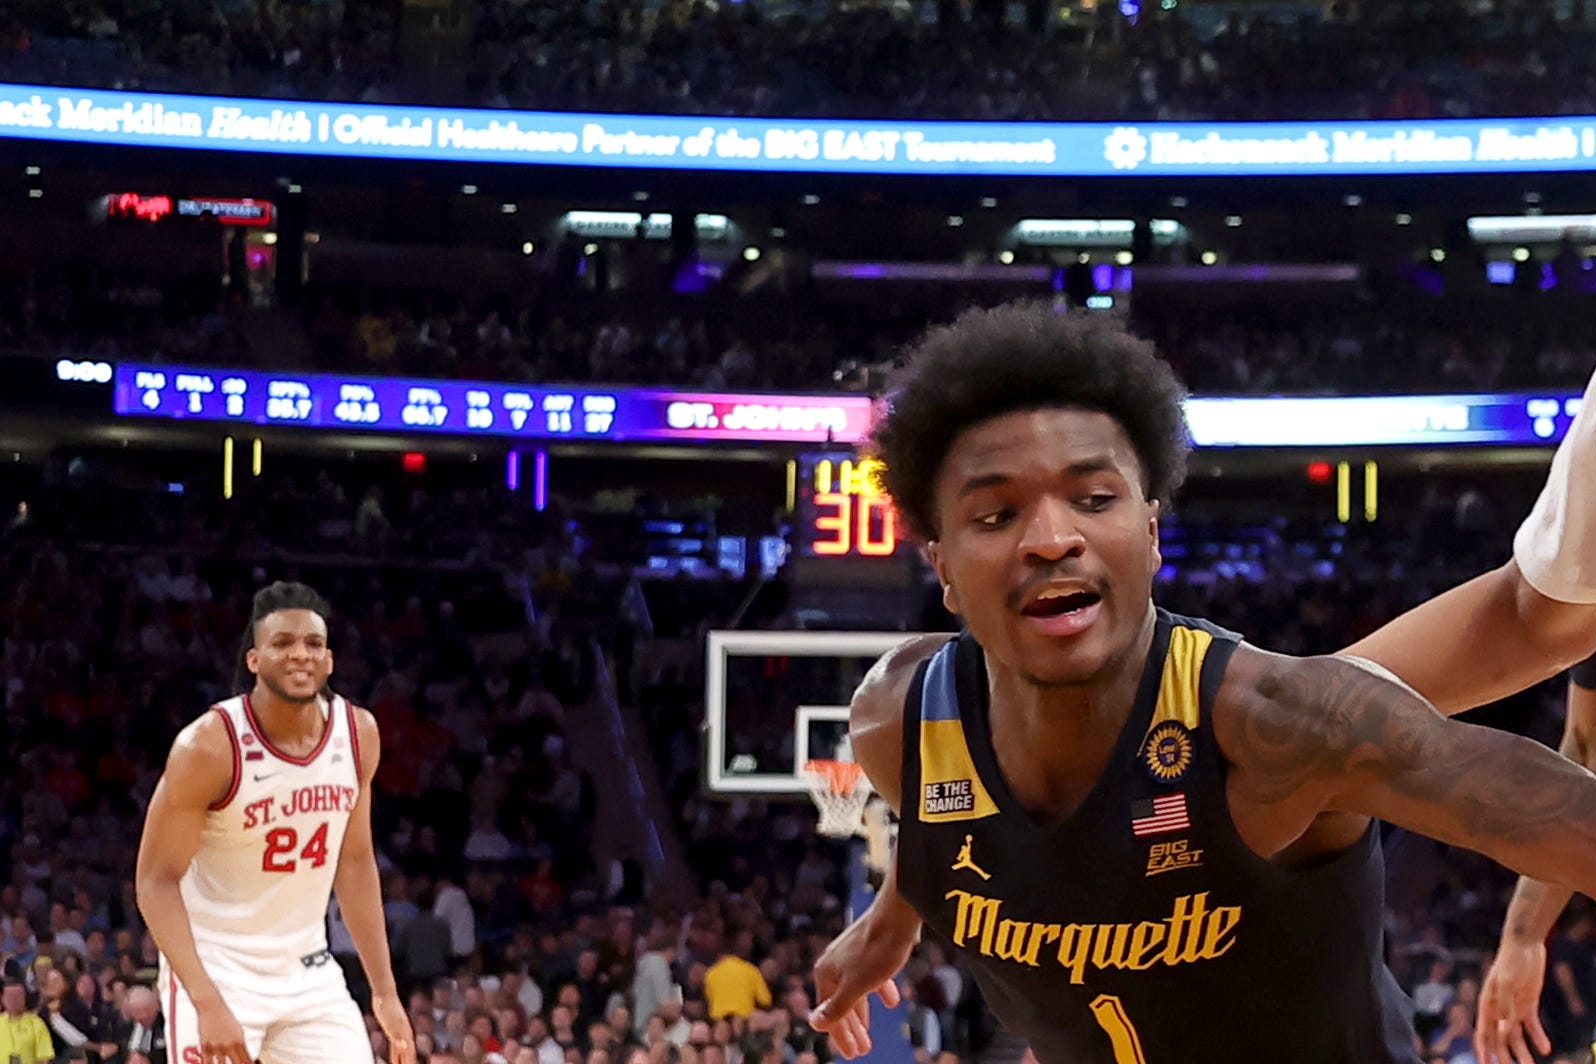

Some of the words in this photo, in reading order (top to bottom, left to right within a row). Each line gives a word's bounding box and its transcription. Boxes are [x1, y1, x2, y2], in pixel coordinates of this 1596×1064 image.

[57, 97, 203, 137] Meridian
[206, 106, 312, 143] Health
[333, 114, 433, 147] Official
[437, 118, 579, 153] Healthcare
[583, 123, 681, 156] Partner
[682, 126, 715, 157] of
[764, 128, 820, 160] BIG
[823, 130, 901, 161] EAST
[901, 131, 1056, 164] Tournament
[813, 493, 896, 555] 30
[243, 798, 277, 830] ST.
[282, 785, 356, 818] JOHN'S
[925, 783, 940, 799] BE
[942, 781, 970, 797] THE
[926, 795, 973, 813] CHANGE
[262, 822, 330, 873] 24
[1146, 849, 1204, 870] EAST
[1149, 839, 1189, 858] BIG
[945, 889, 1242, 985] Marquette
